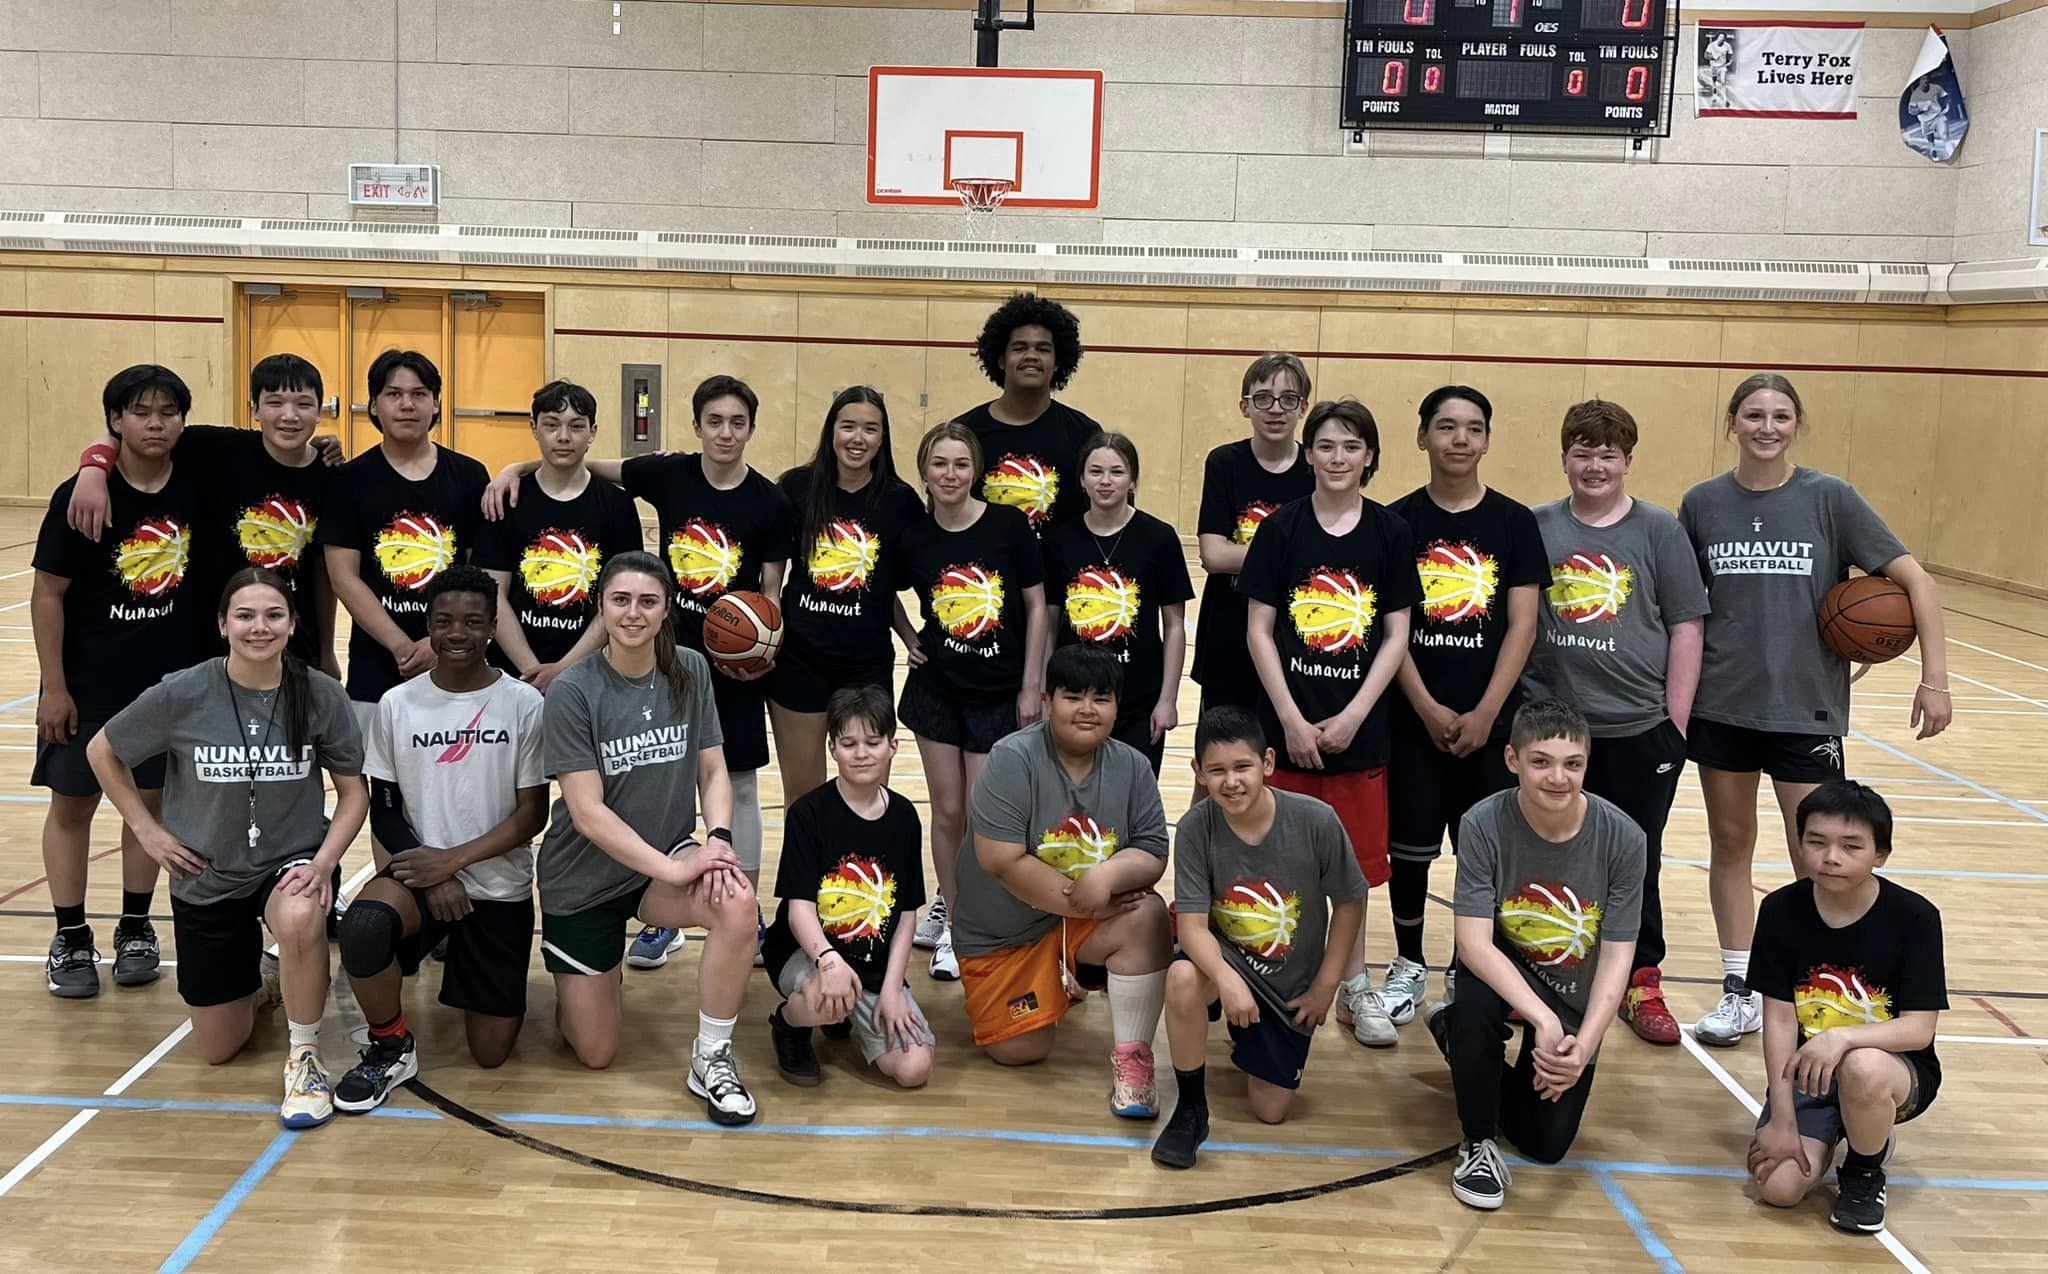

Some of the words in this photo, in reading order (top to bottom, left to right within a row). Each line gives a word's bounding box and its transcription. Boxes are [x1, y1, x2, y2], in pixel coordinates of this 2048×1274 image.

[1534, 22, 1559, 33] OES
[1355, 40, 1374, 53] TM
[1378, 41, 1414, 54] FOULS
[1425, 48, 1443, 59] TOL
[1462, 42, 1507, 57] PLAYER
[1520, 44, 1557, 58] FOULS
[1599, 45, 1617, 59] TM
[1621, 46, 1659, 60] FOULS
[1568, 51, 1587, 63] TOL
[1762, 52, 1812, 69] Terry
[1817, 53, 1851, 68] Fox
[1383, 61, 1404, 95] 0
[1424, 67, 1441, 91] 0
[1568, 70, 1584, 95] 0
[1626, 66, 1649, 100] 0
[1757, 70, 1805, 85] Lives
[1811, 71, 1854, 86] Here
[1362, 100, 1400, 113] POINTS
[1484, 103, 1520, 116] MATCH
[1605, 106, 1643, 119] POINTS
[364, 184, 390, 198] EXIT
[1707, 541, 1813, 559] NUNAVUT
[1715, 560, 1804, 571] BASKETBALL
[382, 595, 428, 613] Nunav
[800, 594, 862, 617] Nunavut
[521, 610, 585, 631] Nunavut
[1413, 629, 1484, 649] Nunavut
[1546, 629, 1617, 652] Nunavut
[1290, 656, 1361, 680] Nunavut
[412, 728, 510, 749] NAUTICA
[600, 723, 689, 758] NUNAVUT
